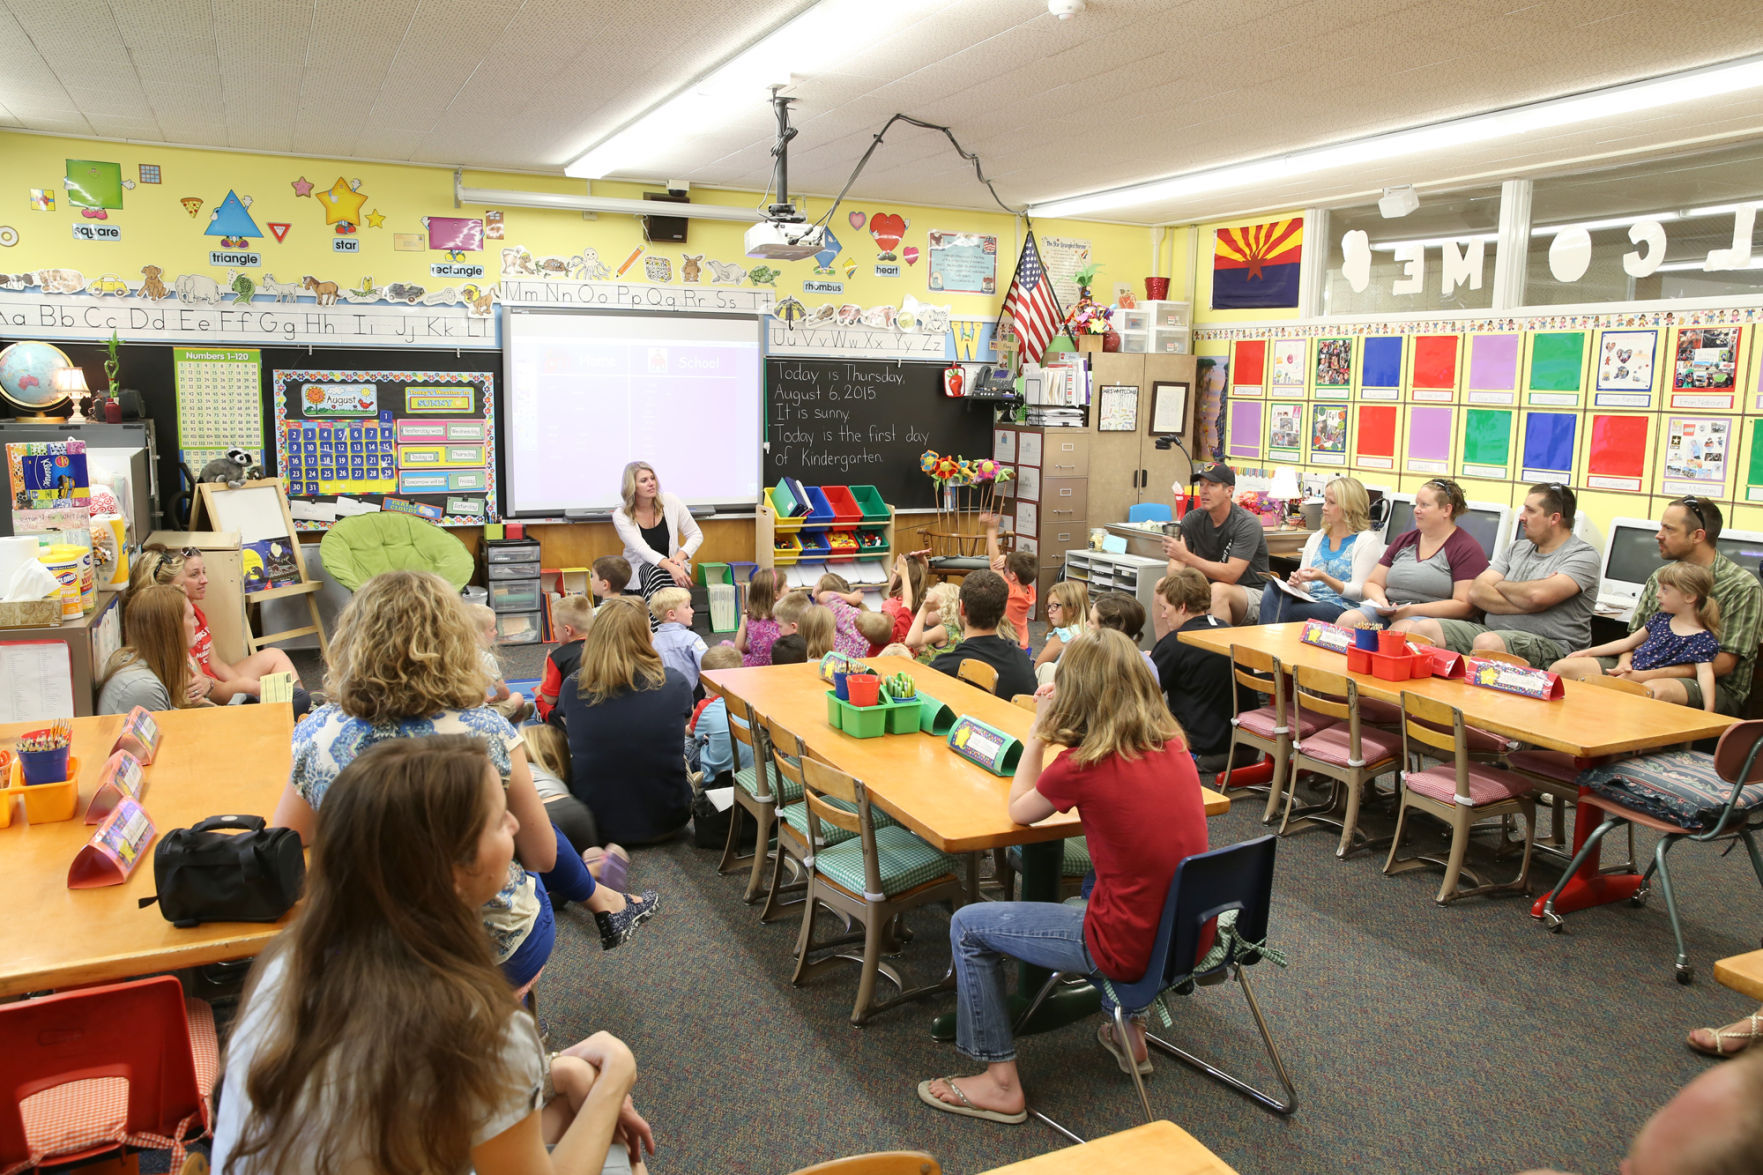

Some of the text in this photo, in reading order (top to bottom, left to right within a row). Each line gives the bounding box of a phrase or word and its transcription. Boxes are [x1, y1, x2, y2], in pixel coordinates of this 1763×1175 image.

[335, 240, 357, 250] star
[212, 253, 258, 266] triangle
[431, 265, 482, 277] rectangle
[876, 265, 898, 276] heart
[805, 281, 842, 293] rhombus
[505, 281, 538, 301] Mm
[546, 283, 572, 302] Nn
[617, 285, 641, 308] Pp
[684, 289, 706, 307] Rr
[40, 304, 75, 328] Bb
[130, 307, 165, 330] Dd
[180, 309, 210, 331] Ee
[220, 310, 253, 332] Ff
[259, 312, 296, 340] Gg
[306, 313, 335, 334] Hh
[395, 315, 416, 343] Jj
[427, 316, 454, 337] Kk
[186, 352, 225, 360] Numbers
[679, 356, 721, 370] School
[774, 361, 820, 384] Today
[828, 371, 839, 381] is
[326, 395, 356, 406] August
[774, 383, 821, 407] August
[843, 384, 877, 400] 2015
[417, 399, 453, 407] SUNNY
[776, 402, 791, 420] It
[797, 408, 808, 419] is
[774, 423, 930, 447] Today is the first day
[775, 445, 792, 466] of
